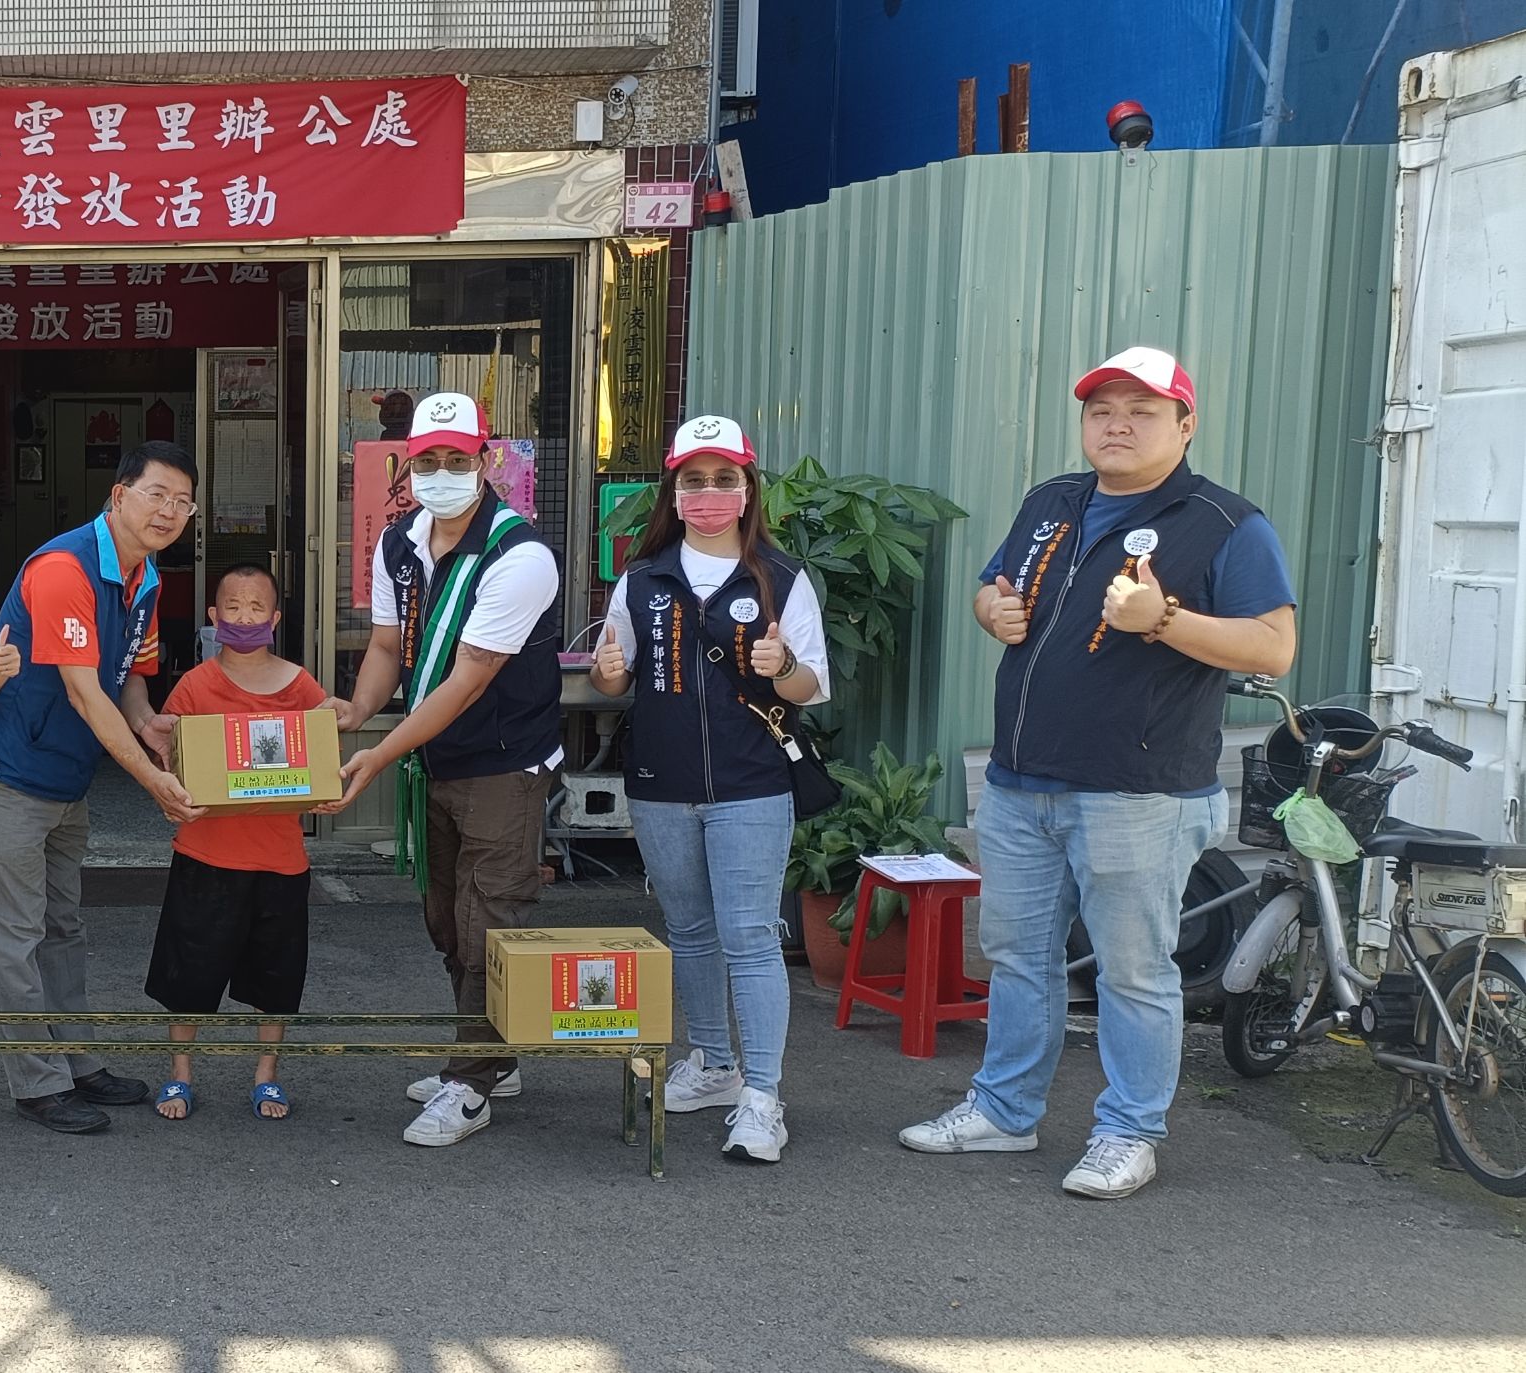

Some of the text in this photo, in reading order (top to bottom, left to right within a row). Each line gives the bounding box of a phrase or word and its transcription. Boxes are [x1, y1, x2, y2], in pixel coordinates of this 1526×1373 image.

[645, 203, 678, 223] 42
[618, 306, 646, 466] 凌雲里辦公處
